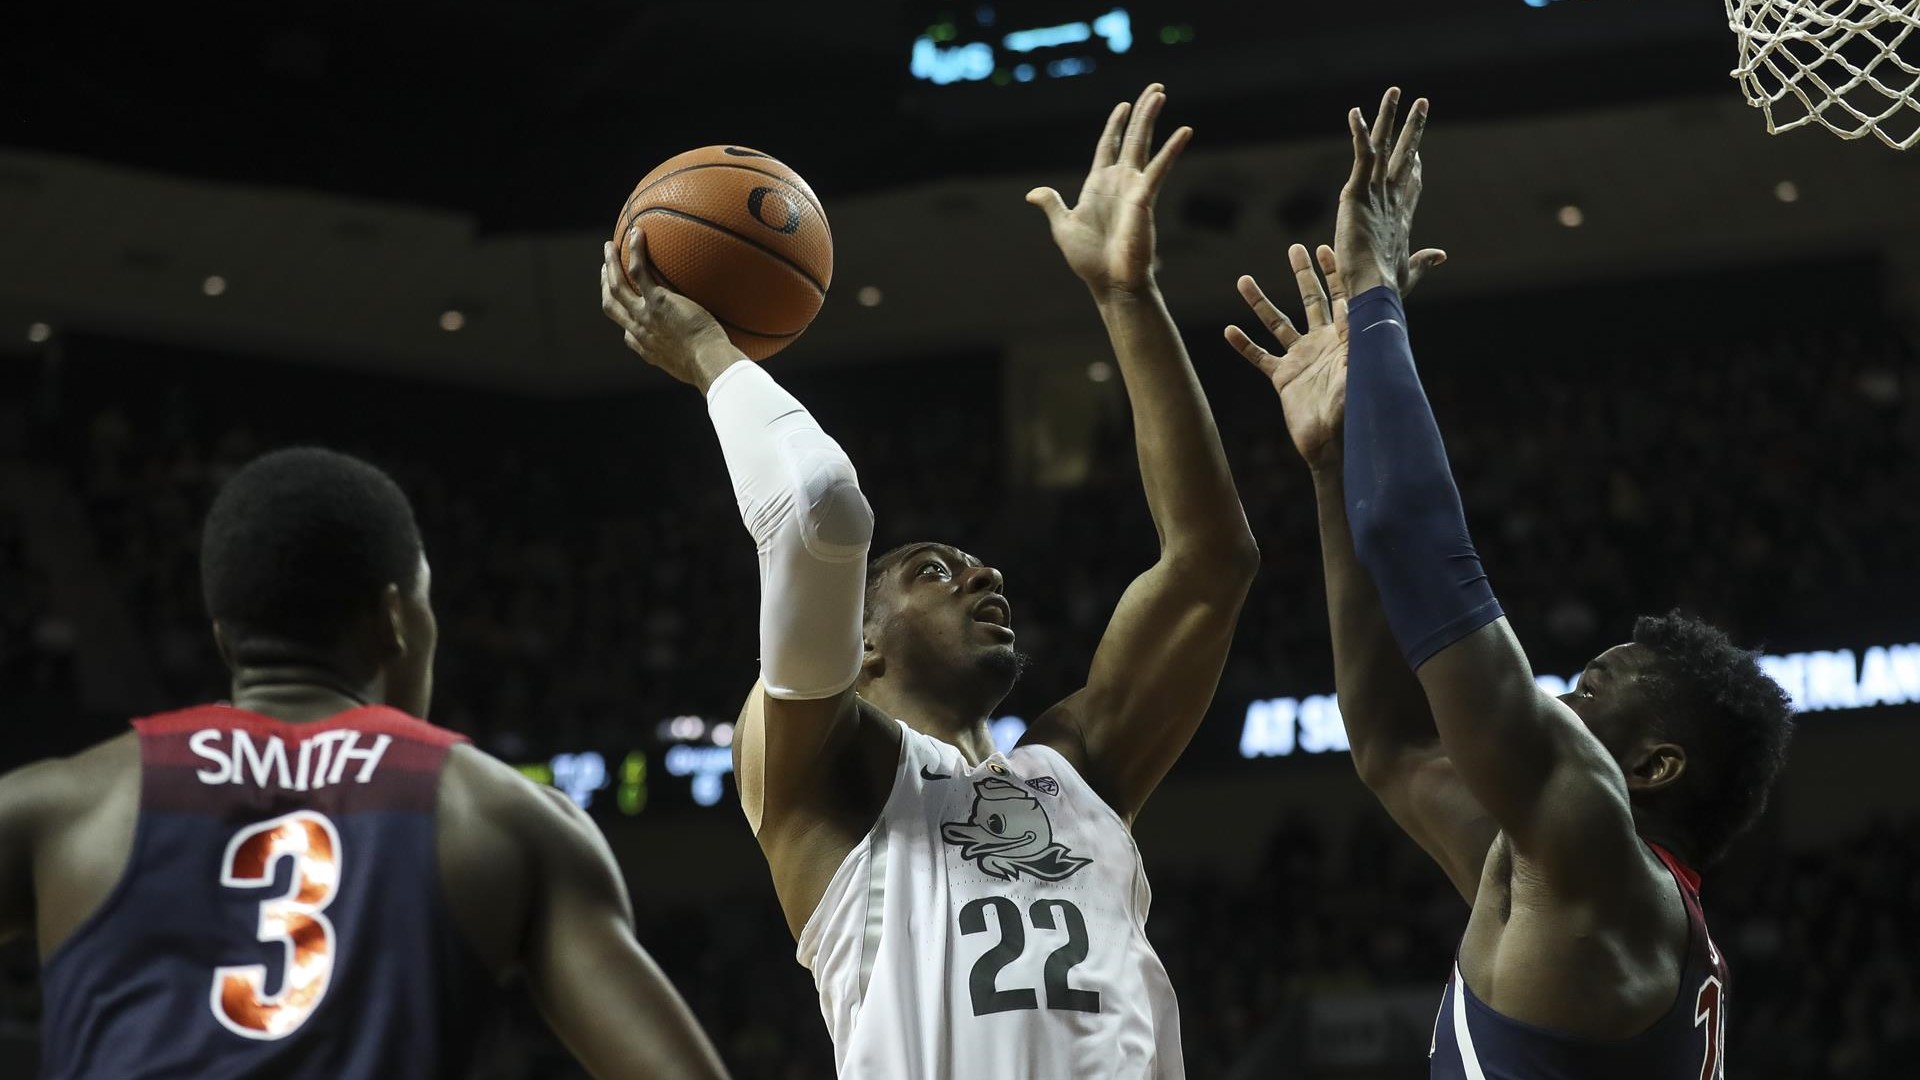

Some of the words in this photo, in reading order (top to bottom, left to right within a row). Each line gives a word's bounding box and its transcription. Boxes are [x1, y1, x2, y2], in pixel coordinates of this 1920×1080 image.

[189, 728, 393, 792] SMITH
[210, 809, 343, 1041] 3
[959, 896, 1100, 1017] 22
